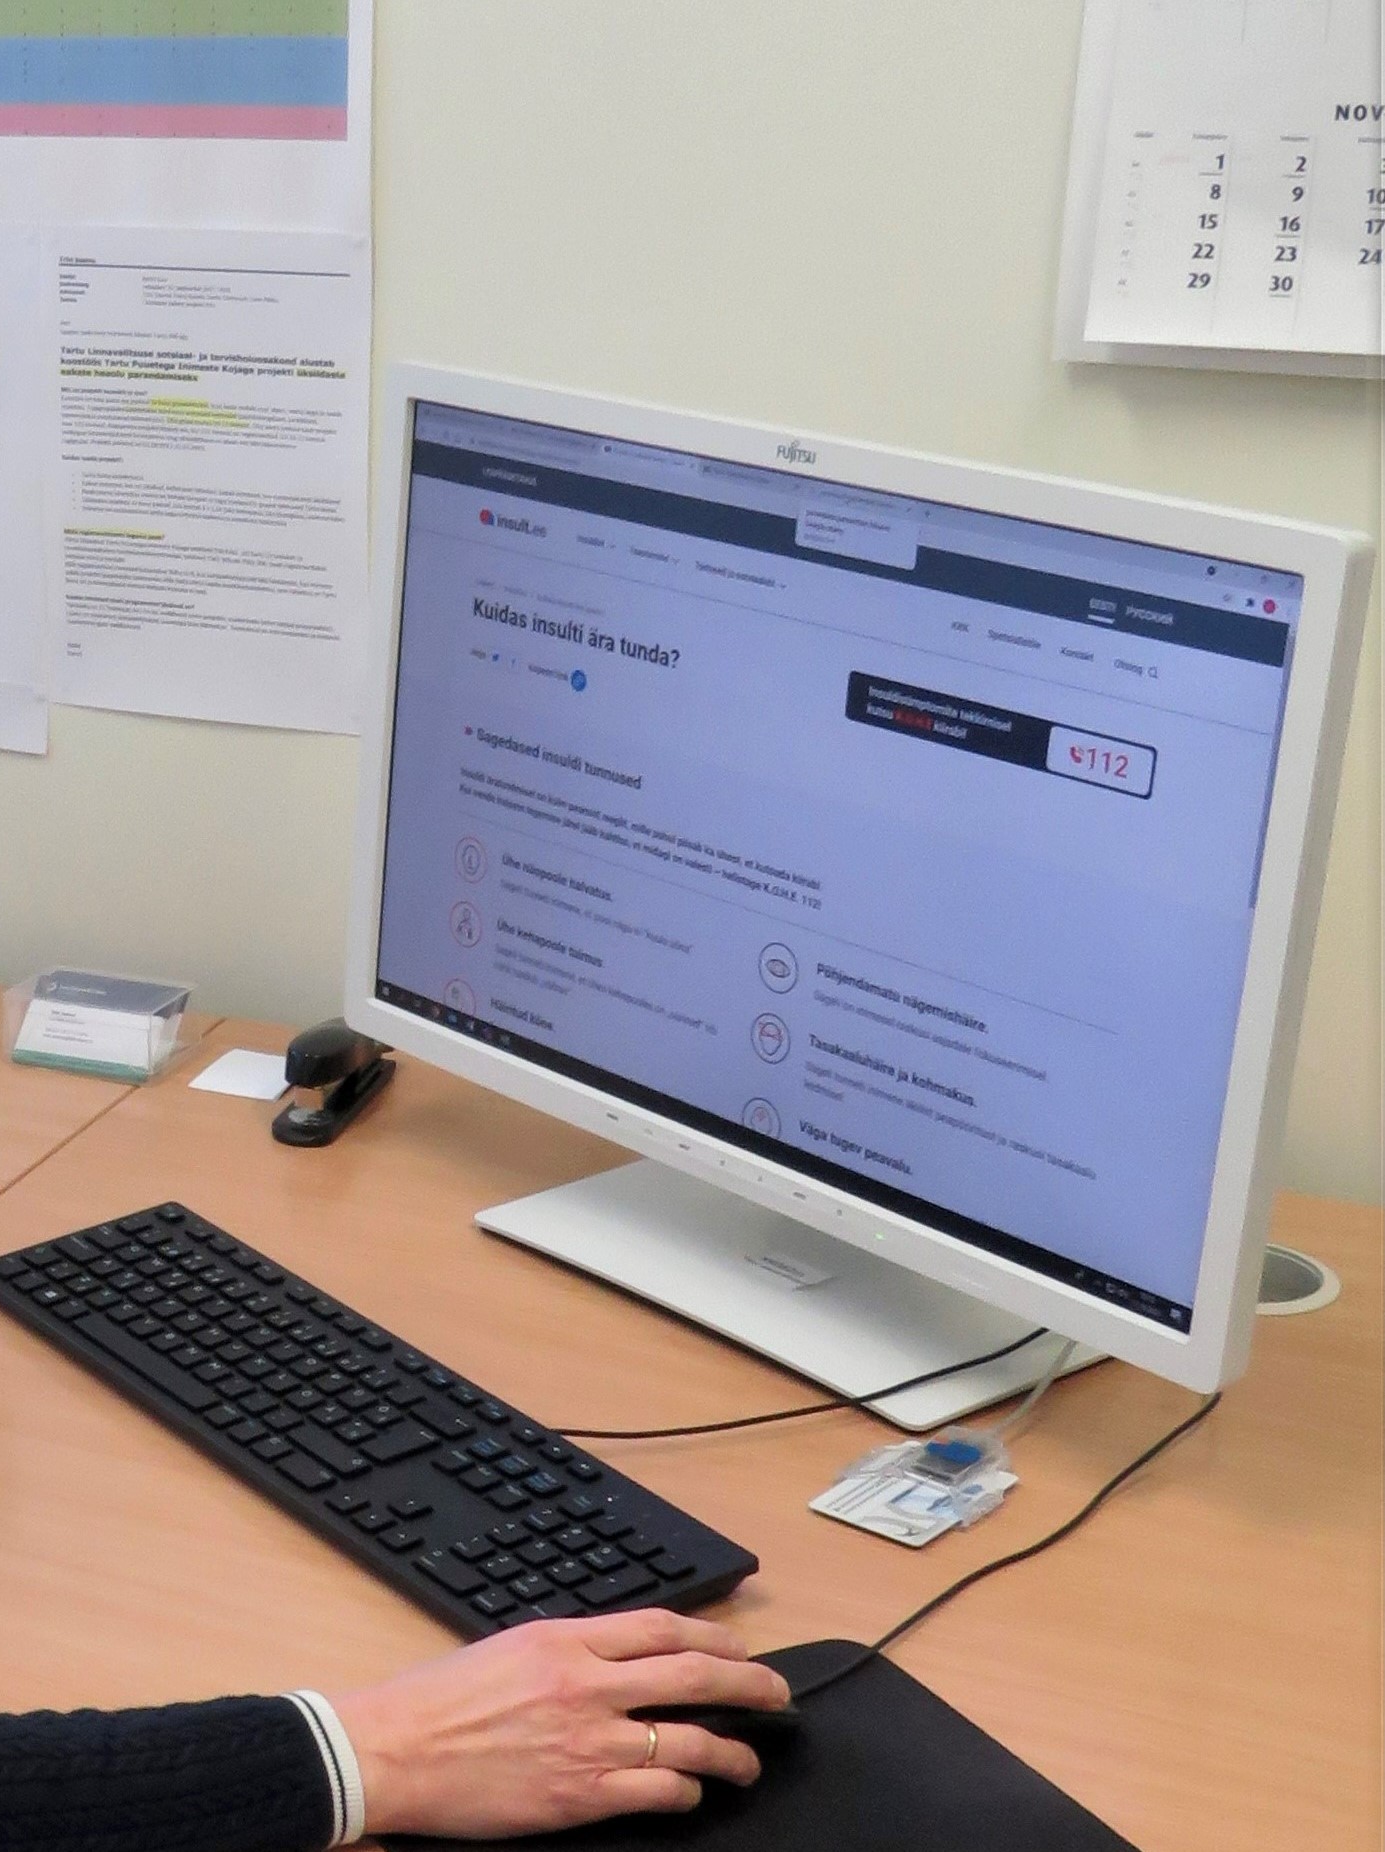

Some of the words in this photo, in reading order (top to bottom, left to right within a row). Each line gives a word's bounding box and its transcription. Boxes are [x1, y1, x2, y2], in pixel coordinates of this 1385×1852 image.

[1216, 154, 1225, 169] 1
[1295, 156, 1307, 172] 2
[1210, 184, 1221, 200] 8
[1292, 187, 1304, 202] 9
[1199, 213, 1218, 229] 15
[1280, 216, 1301, 232] 16
[1365, 219, 1385, 235] 17
[1192, 243, 1215, 259] 22
[1274, 246, 1297, 262] 23
[1358, 248, 1383, 265] 24
[1187, 273, 1211, 288] 29
[1269, 276, 1293, 291] 30
[61, 346, 85, 355] Tartu
[199, 352, 208, 362] ja
[105, 359, 129, 368] Tartu
[257, 366, 293, 377] projekti
[776, 444, 817, 464] FUJITSU
[473, 596, 527, 627] Kuidas
[532, 612, 583, 642] insulti
[587, 628, 615, 652] ära
[619, 635, 680, 669] tunda?
[477, 727, 540, 758] Sagedased
[1085, 747, 1129, 777] 112
[896, 1067, 909, 1084] ja
[798, 1120, 827, 1143] Väga
[829, 1132, 862, 1157] tugev
